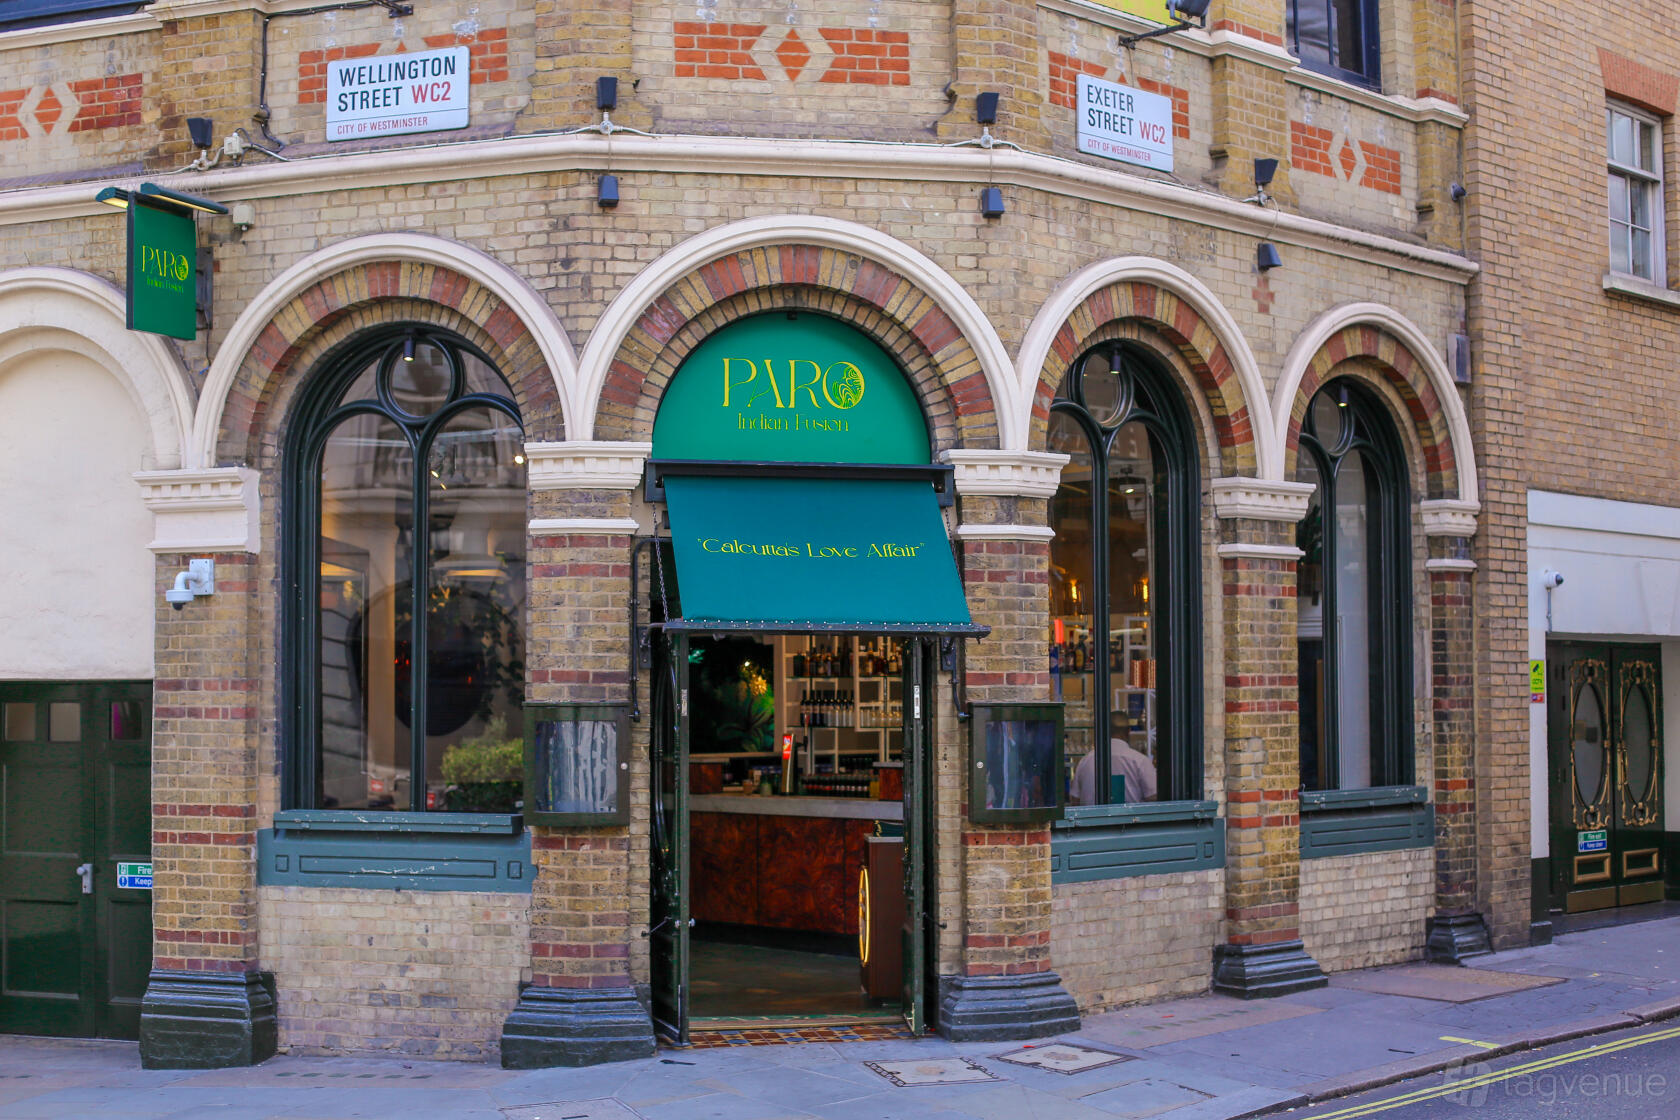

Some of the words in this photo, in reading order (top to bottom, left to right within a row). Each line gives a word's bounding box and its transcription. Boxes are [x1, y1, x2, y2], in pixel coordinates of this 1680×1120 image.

[339, 56, 456, 87] WELLINGTON
[338, 86, 402, 112] STREET
[411, 81, 451, 104] WC2
[1087, 84, 1134, 113] EXETER
[337, 124, 355, 135] CITY
[357, 122, 368, 133] OF
[370, 116, 428, 131] WESTMINSTER
[1088, 108, 1134, 136] STREET
[1139, 120, 1166, 145] WC2
[1087, 138, 1100, 150] CITY
[1102, 142, 1110, 152] OF
[1111, 144, 1152, 161] WESTMINSTER
[142, 245, 189, 281] PARO
[722, 358, 865, 410] PARO
[738, 413, 788, 430] Indian
[795, 413, 849, 432] Fusion
[806, 543, 857, 558] Love
[135, 877, 152, 887] Keep
[137, 866, 152, 875] Fire
